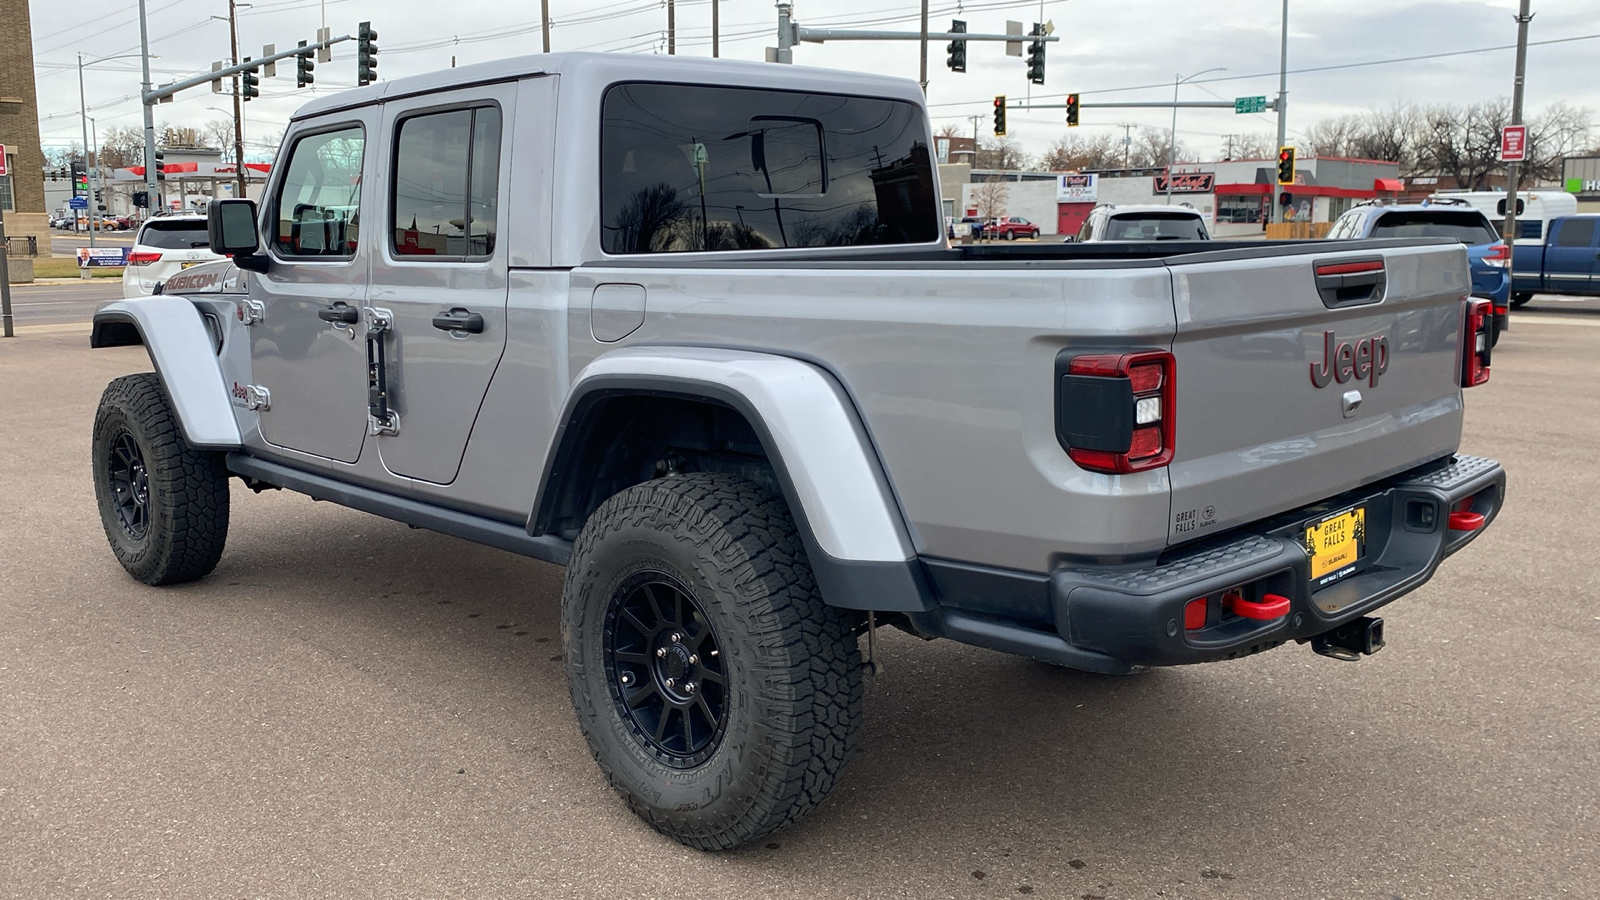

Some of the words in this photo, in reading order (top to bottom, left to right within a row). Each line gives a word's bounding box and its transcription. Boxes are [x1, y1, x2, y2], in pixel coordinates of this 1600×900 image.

[164, 273, 219, 291] RUBICON
[1310, 330, 1390, 389] Jeep
[1175, 509, 1196, 523] GREAT
[1175, 520, 1195, 534] FALLS
[1324, 518, 1346, 536] GREAT
[1323, 530, 1346, 549] FALLS
[1327, 553, 1348, 565] SUBARU
